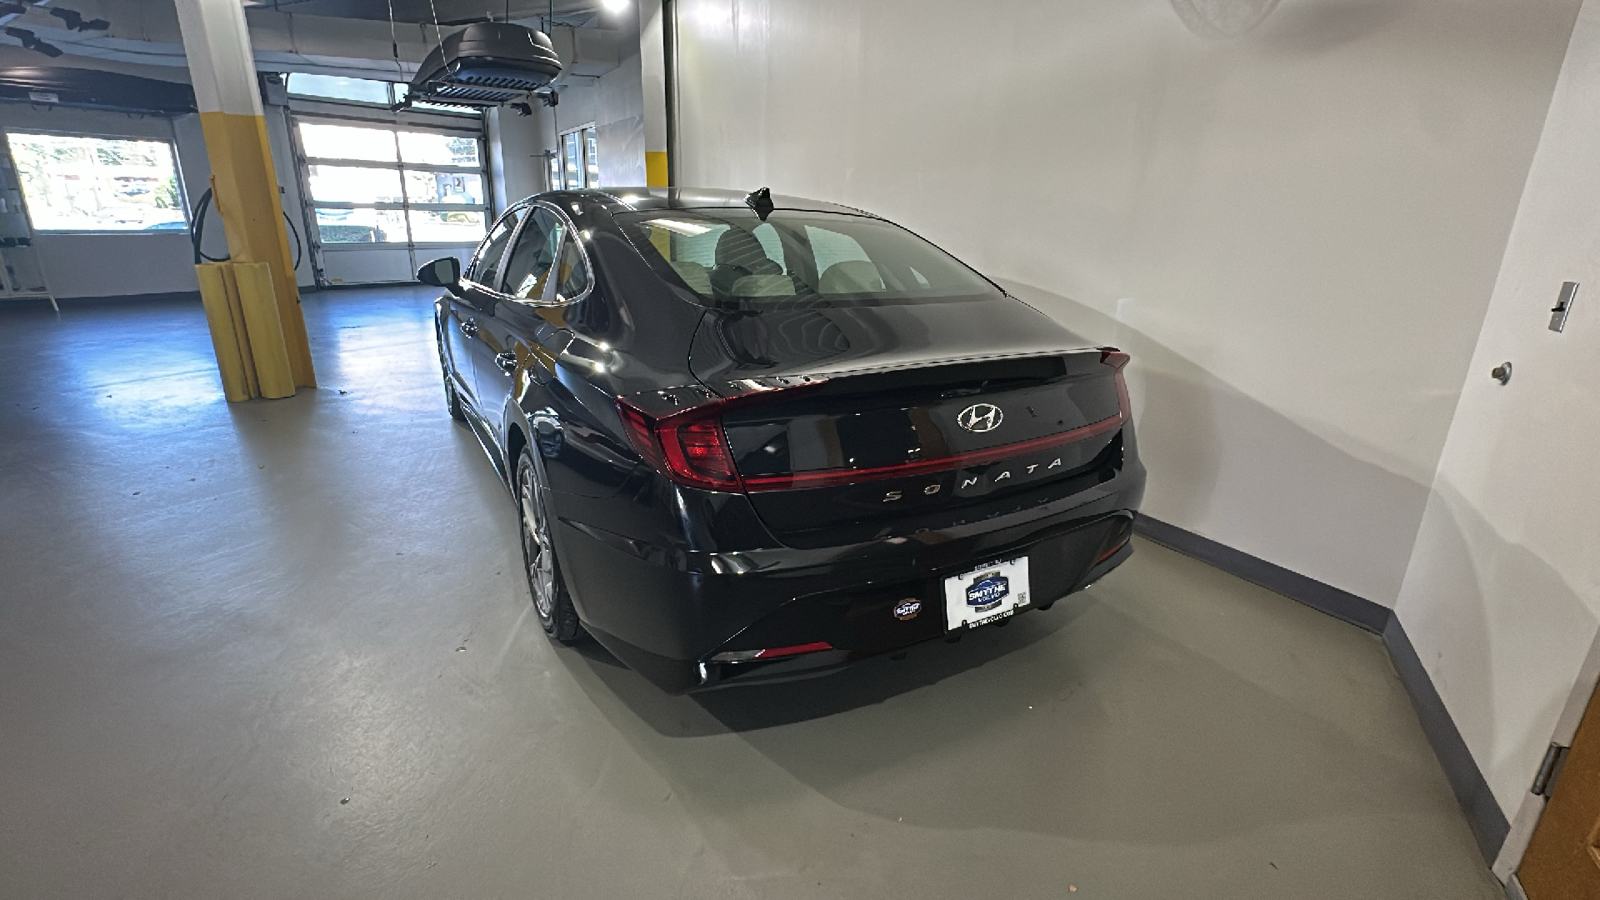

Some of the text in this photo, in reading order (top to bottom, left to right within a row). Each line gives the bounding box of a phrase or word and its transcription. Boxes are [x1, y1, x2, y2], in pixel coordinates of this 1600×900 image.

[882, 457, 1062, 502] SONATA
[969, 584, 1006, 601] SMYTHE
[977, 592, 1001, 603] VOLVO
